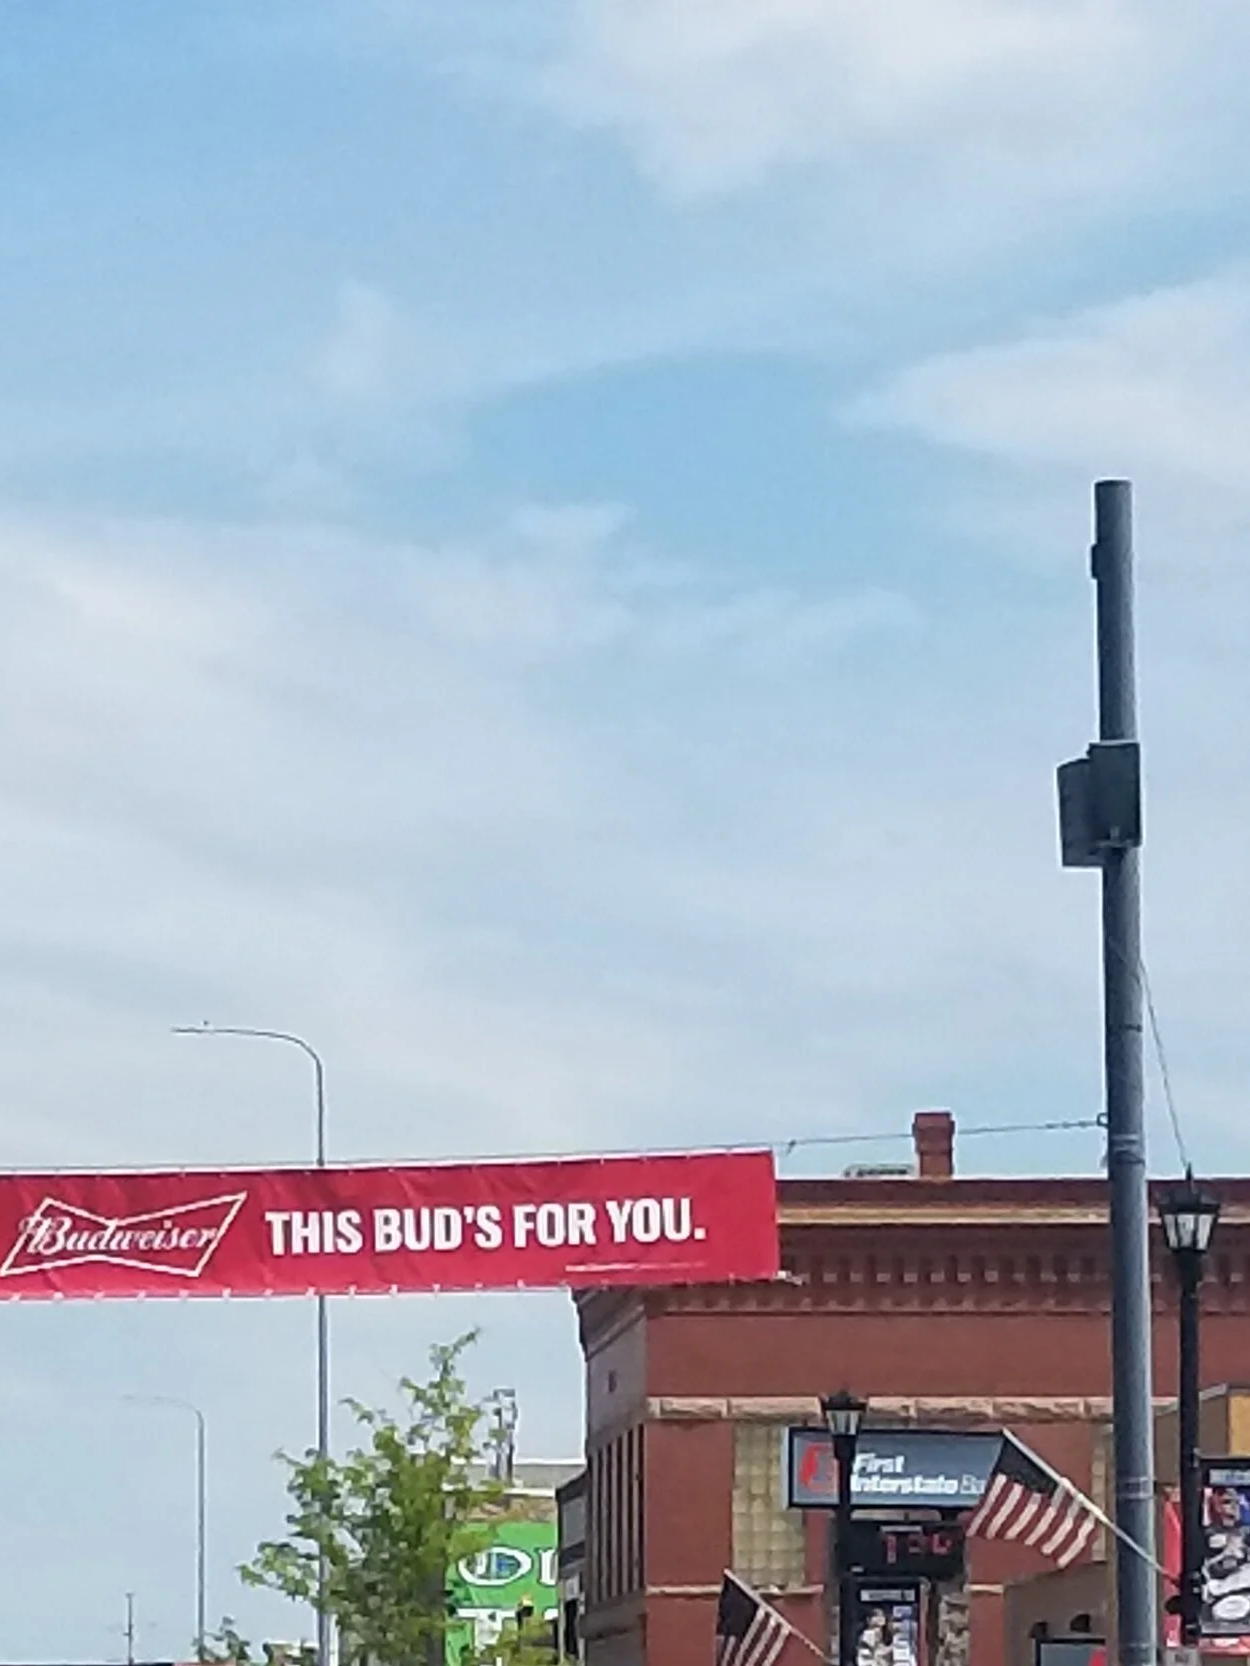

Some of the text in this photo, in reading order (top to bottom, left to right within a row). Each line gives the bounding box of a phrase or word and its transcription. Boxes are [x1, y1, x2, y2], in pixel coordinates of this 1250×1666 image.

[18, 1196, 707, 1256] Budweiser THIS BUD'S FOR YOU.
[852, 1452, 905, 1474] First
[851, 1473, 959, 1494] Interstate
